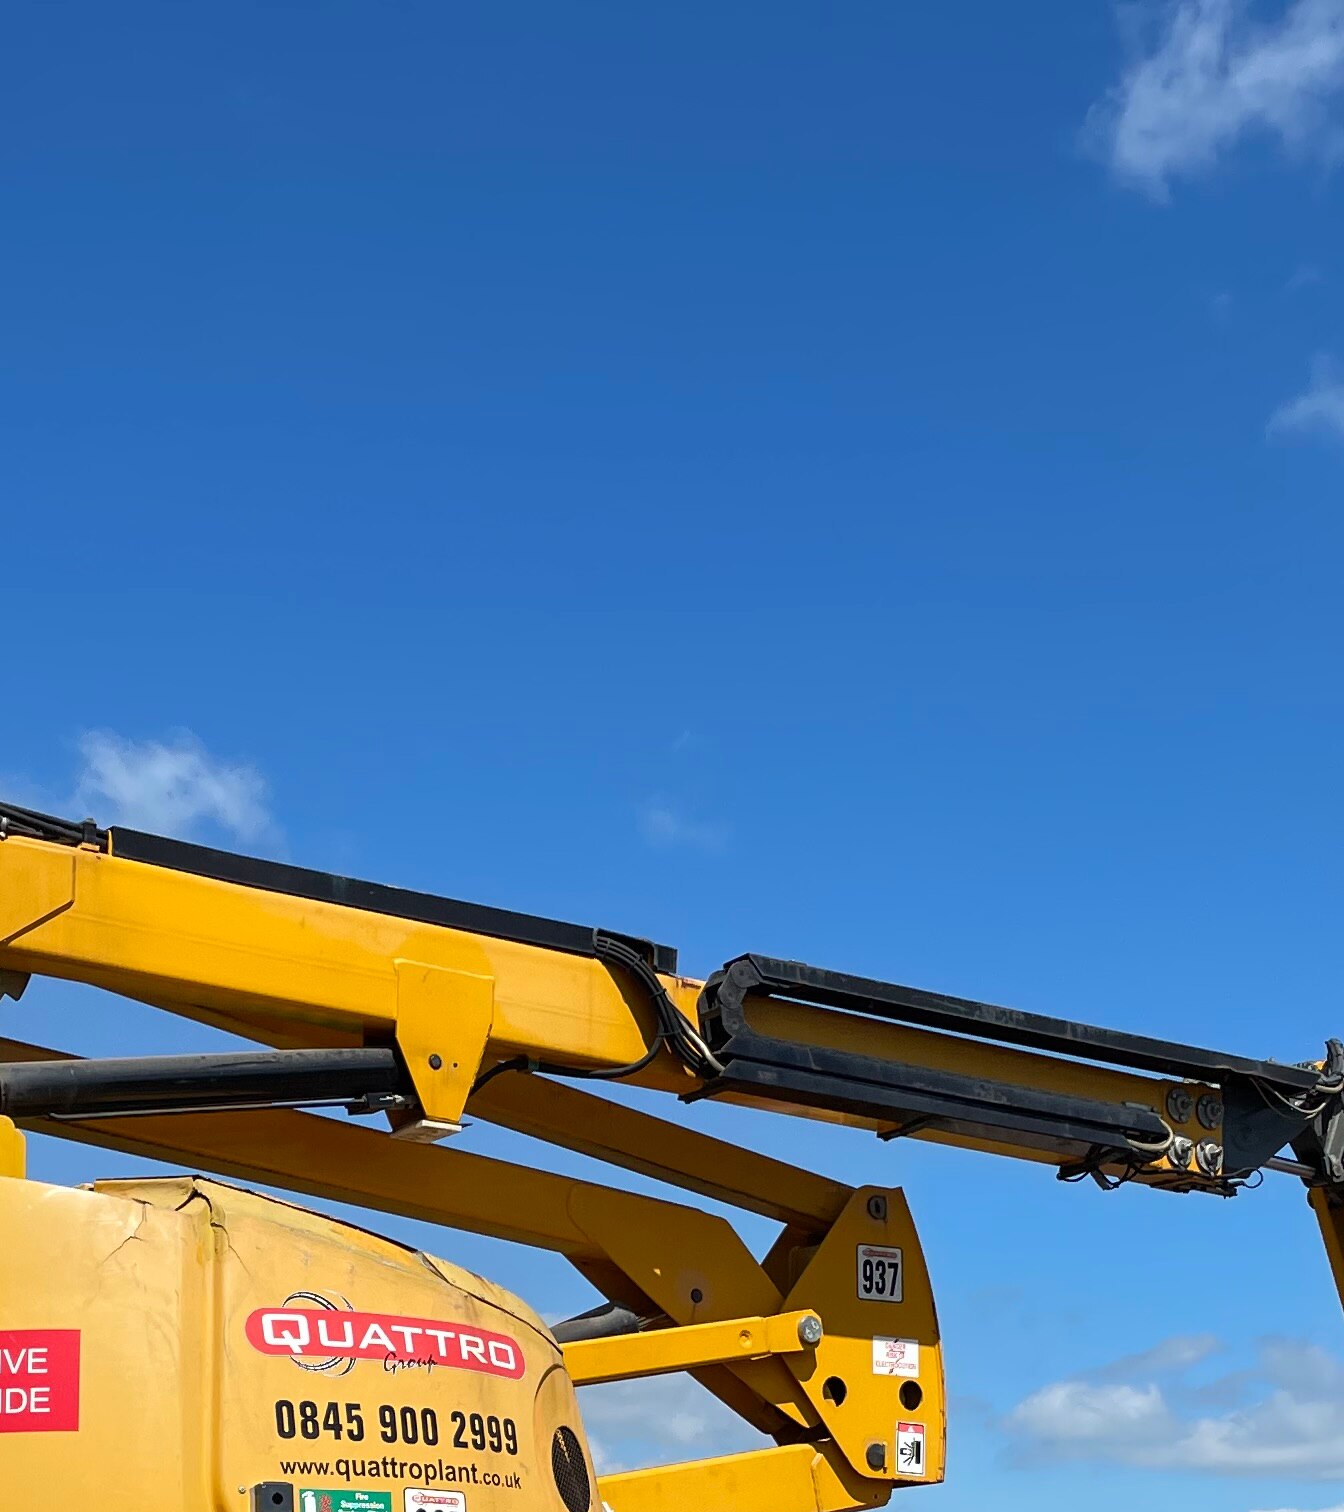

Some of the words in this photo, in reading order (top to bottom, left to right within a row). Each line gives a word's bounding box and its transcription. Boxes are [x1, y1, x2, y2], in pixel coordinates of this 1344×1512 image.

[862, 1259, 899, 1297] 937
[261, 1313, 516, 1371] QUATTRO
[383, 1351, 439, 1375] Group
[275, 1399, 365, 1442] 0845
[378, 1404, 439, 1446] 900
[450, 1410, 519, 1456] 2999
[280, 1456, 522, 1490] www.quattroplant.co.uk
